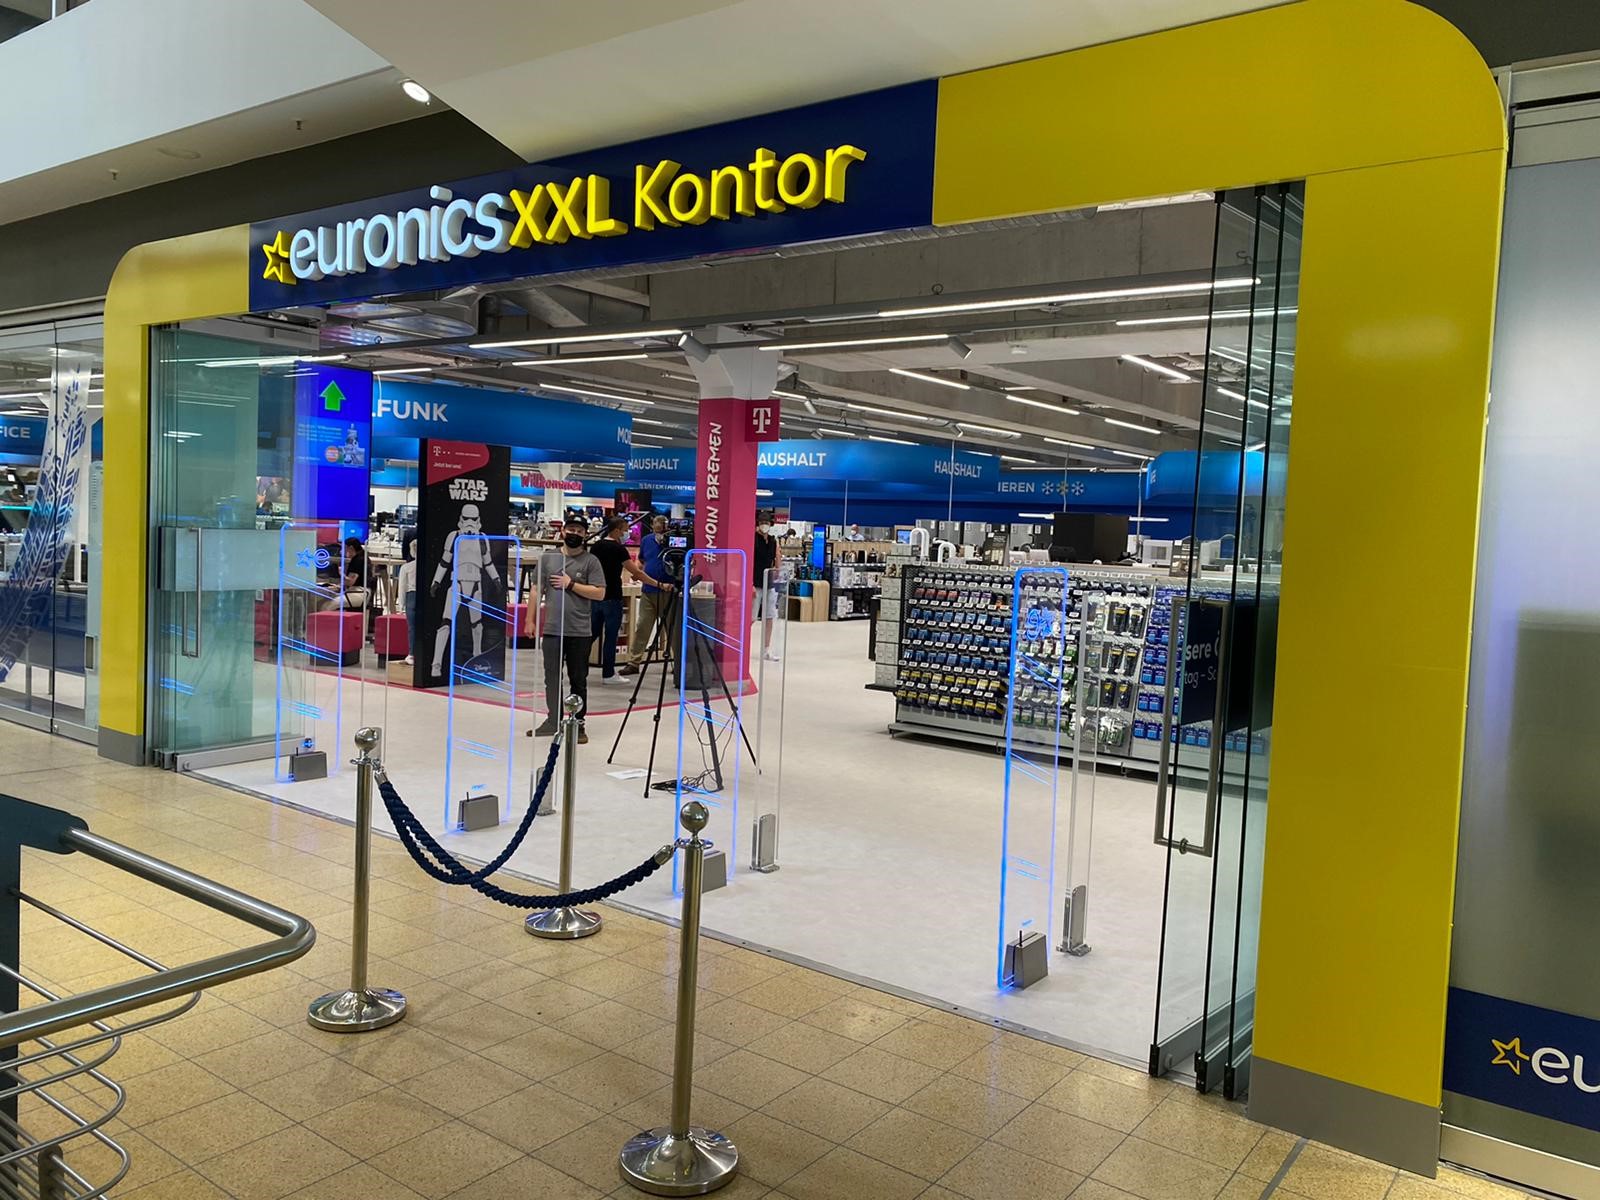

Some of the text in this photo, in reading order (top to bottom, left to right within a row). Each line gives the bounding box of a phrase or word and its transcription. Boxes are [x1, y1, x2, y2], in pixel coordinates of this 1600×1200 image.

[635, 145, 867, 231] Kontor
[372, 399, 448, 422] FUNK
[706, 422, 722, 500] BREMEN
[934, 460, 982, 479] HAUSHALT
[449, 478, 488, 491] STAR
[449, 489, 488, 501] WARS
